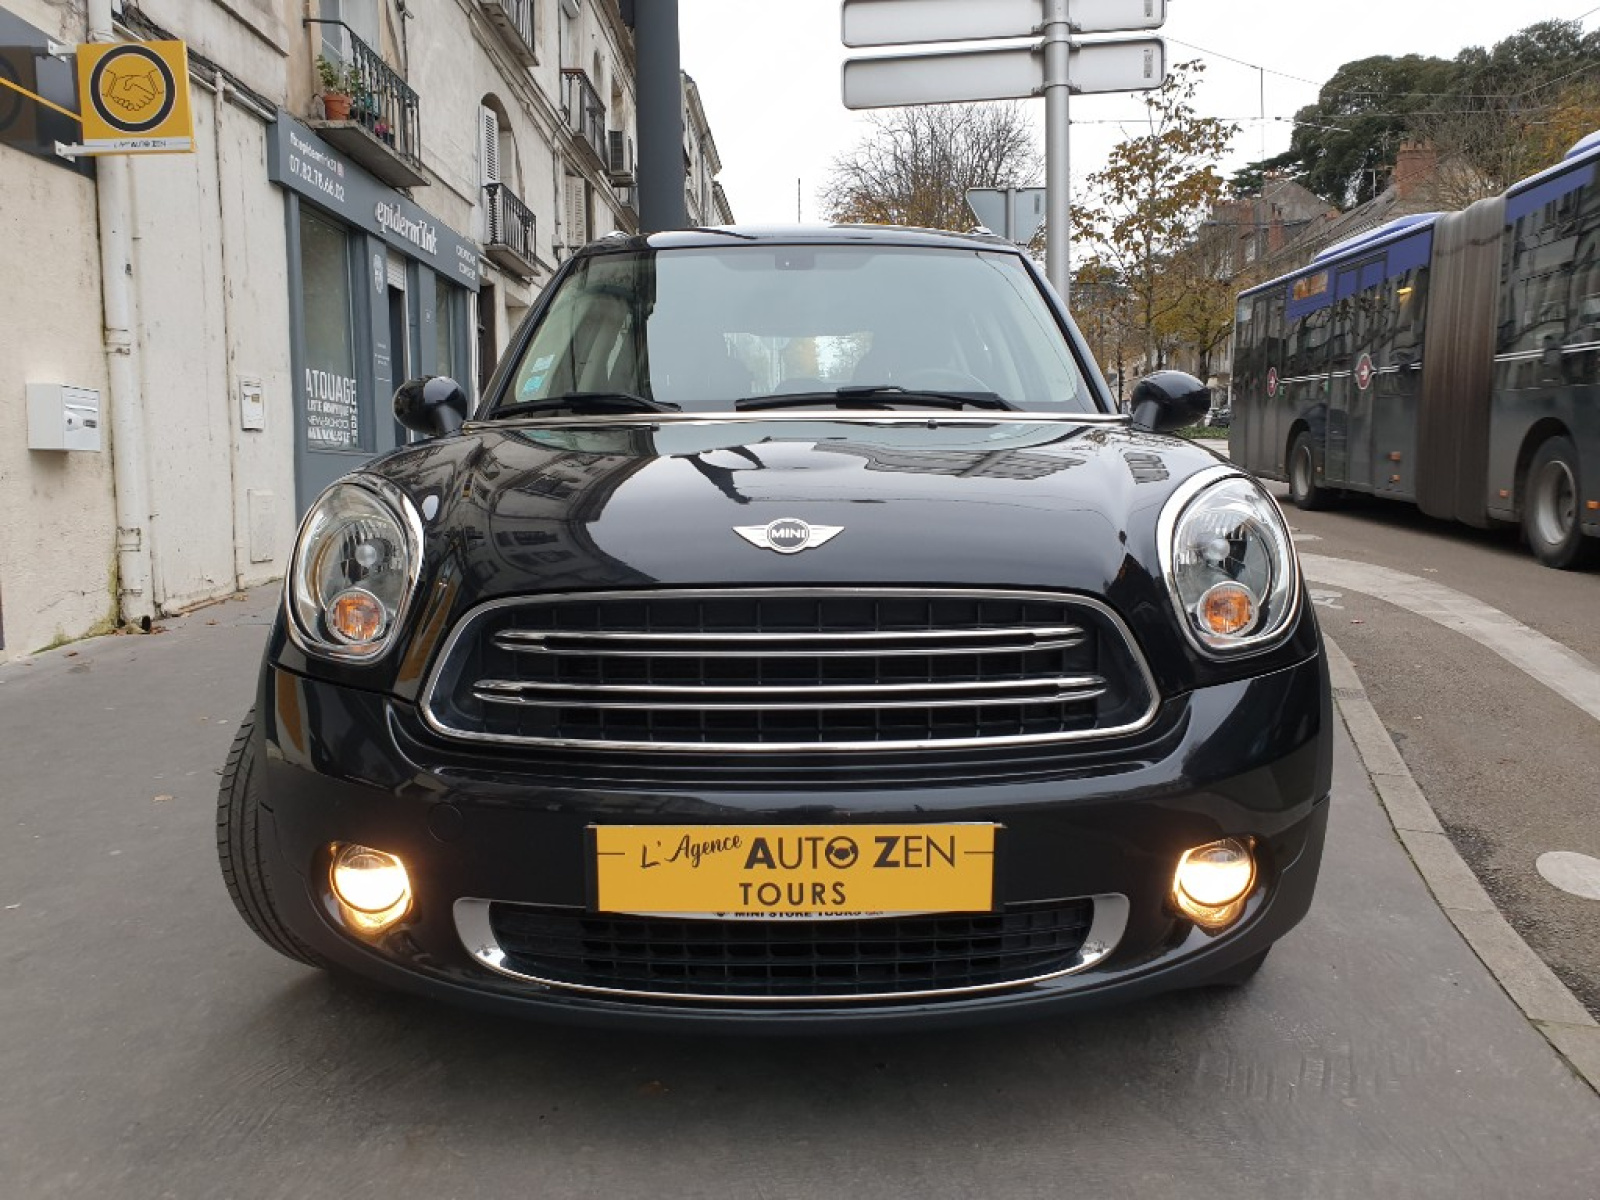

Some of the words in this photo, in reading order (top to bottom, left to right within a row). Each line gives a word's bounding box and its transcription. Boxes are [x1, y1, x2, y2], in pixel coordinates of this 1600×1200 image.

[771, 527, 805, 538] MINI
[744, 836, 859, 870] AUTO
[873, 835, 955, 868] ZEN
[739, 881, 846, 906] TOURS
